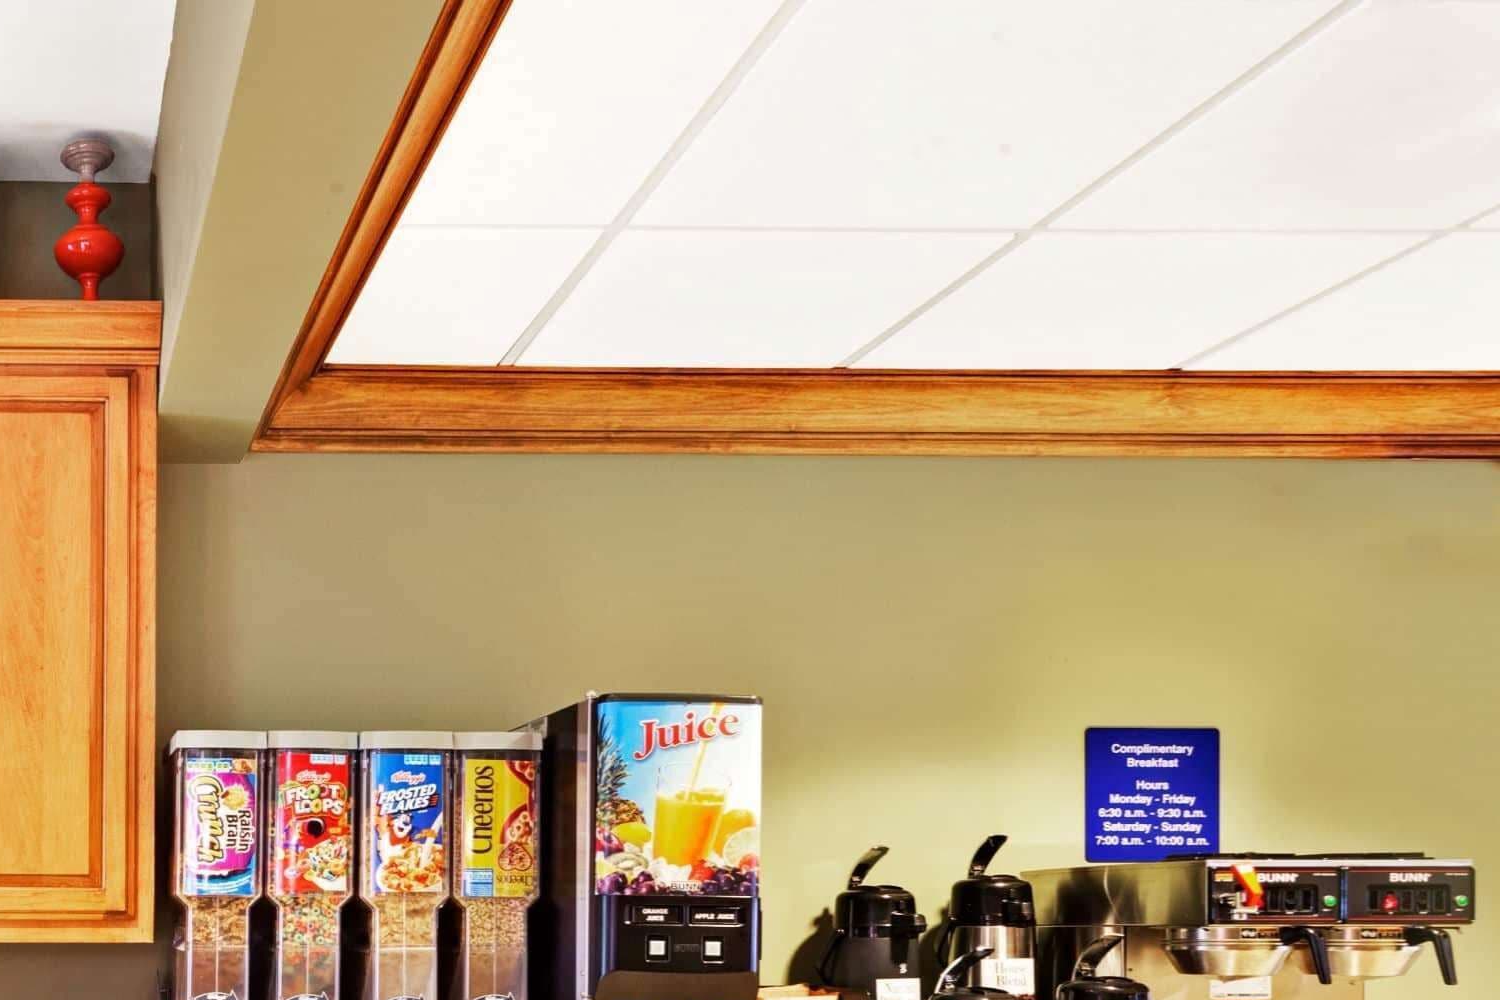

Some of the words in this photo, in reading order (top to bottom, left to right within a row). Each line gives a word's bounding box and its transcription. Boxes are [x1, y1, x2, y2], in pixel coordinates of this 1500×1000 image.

[634, 711, 740, 760] Juice
[1111, 743, 1194, 756] Complimentary
[1126, 757, 1179, 768] Breakfast
[1135, 779, 1170, 790] Hours
[285, 784, 342, 803] FROOT
[379, 784, 437, 806] FROSTED
[1109, 793, 1153, 806] Monday
[1162, 793, 1196, 806] Friday
[294, 799, 345, 816] LOOPS
[381, 796, 430, 816] FLAKES
[471, 765, 495, 855] Cheerios
[1123, 808, 1148, 818] a.m.
[1183, 808, 1207, 818] a.m.
[191, 775, 225, 864] Crunch
[226, 814, 239, 849] Bran
[238, 810, 252, 853] Raisin
[1102, 821, 1152, 834] Saturday
[1161, 821, 1203, 834] Sunday
[1095, 835, 1119, 846] 7:00
[1121, 836, 1145, 846] a.m.
[1154, 835, 1184, 846] 10:00
[1186, 836, 1210, 846] a.m.
[1257, 873, 1297, 883] BUNN
[1389, 873, 1429, 883] BUNN
